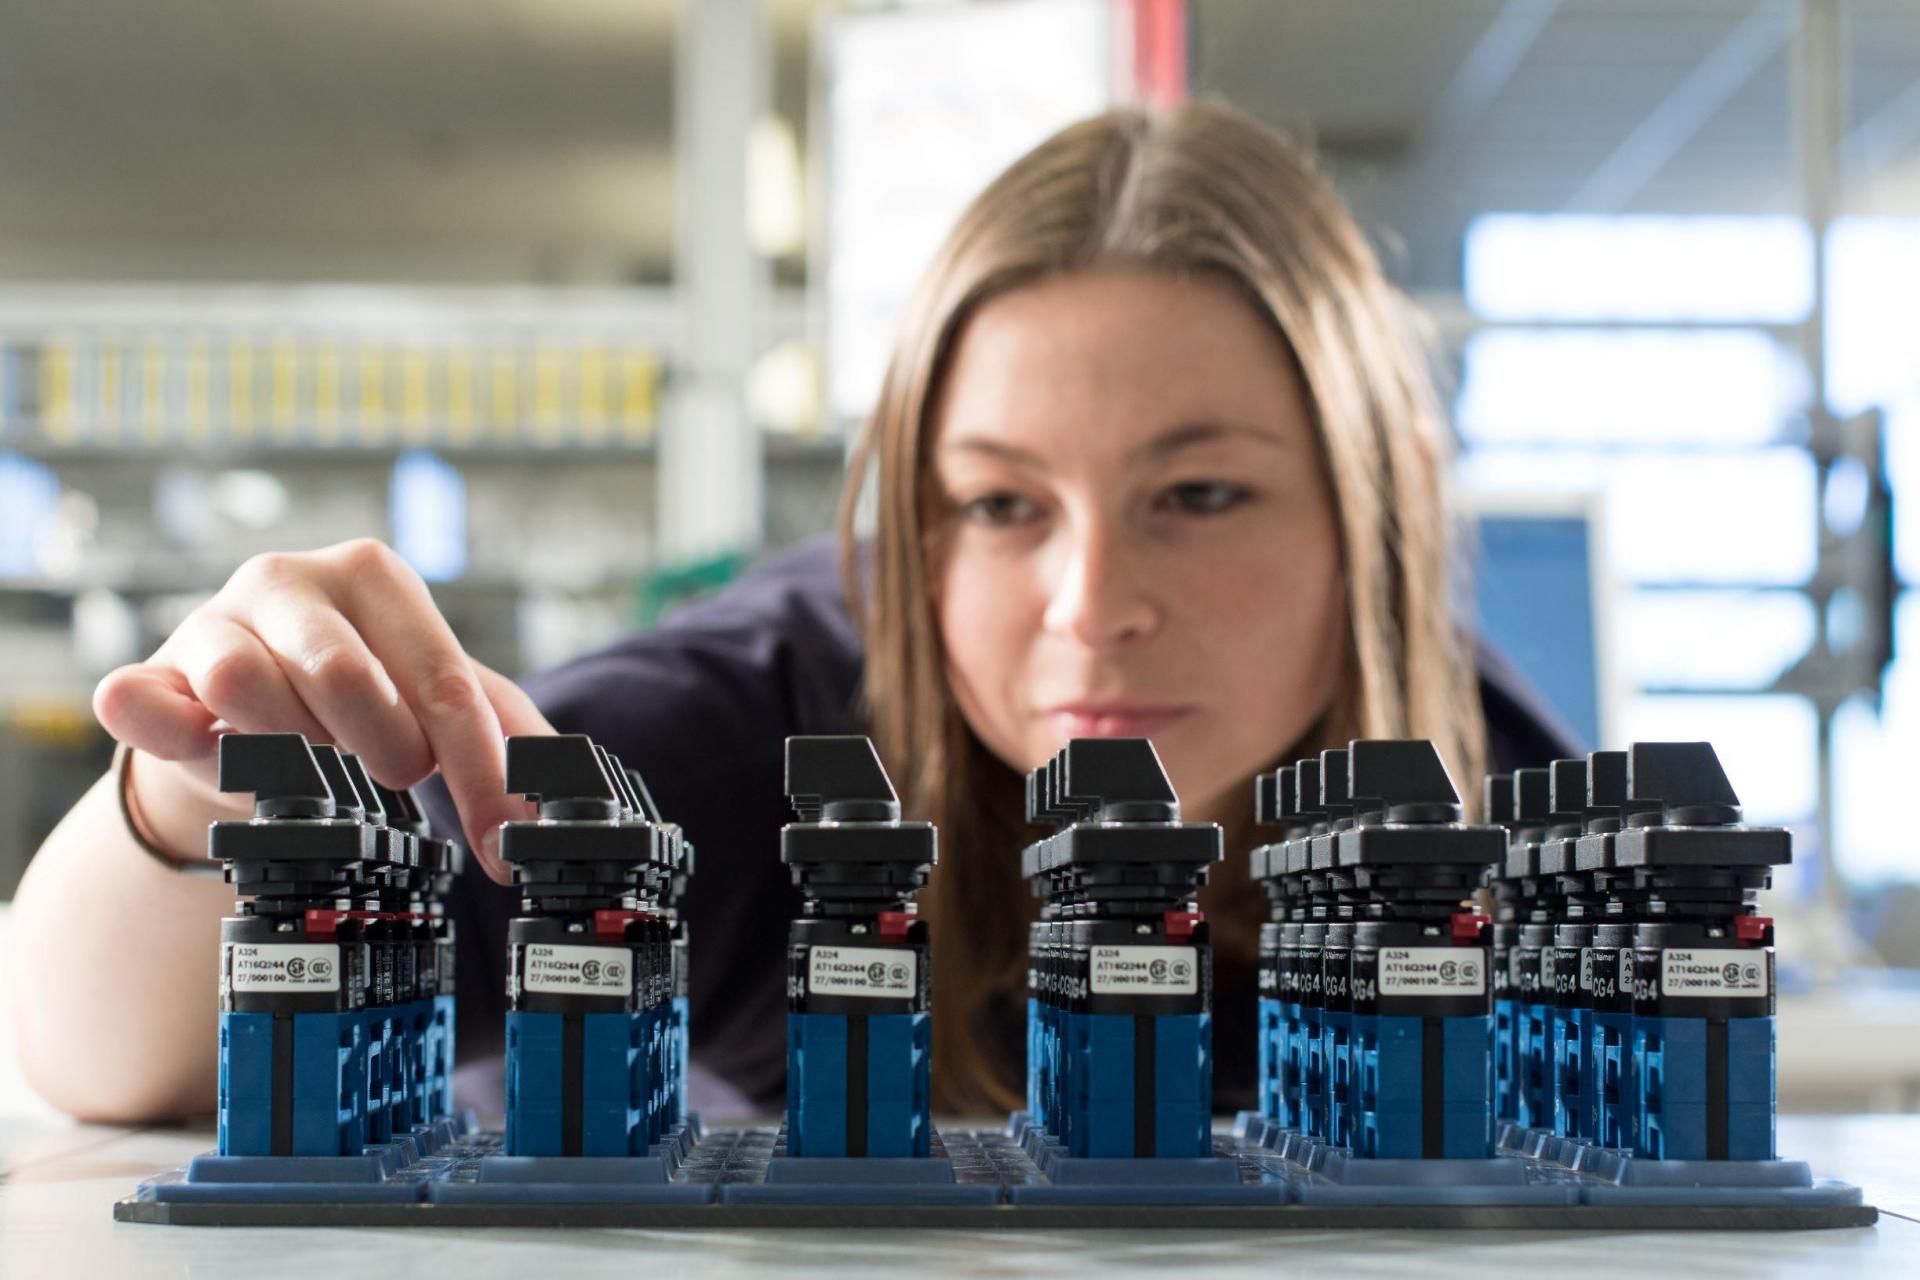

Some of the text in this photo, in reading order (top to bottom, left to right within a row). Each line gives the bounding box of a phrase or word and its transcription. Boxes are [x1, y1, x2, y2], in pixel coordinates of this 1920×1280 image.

[238, 948, 258, 956] A324
[531, 948, 553, 956] A324
[1096, 949, 1120, 957] A324
[1385, 951, 1409, 959] A324
[1668, 953, 1692, 961] A324
[238, 961, 285, 969] AT16Q244
[1300, 973, 1320, 992] CG4
[1325, 976, 1346, 996] CG4
[1556, 974, 1576, 993] CG4
[1593, 977, 1615, 997] CG4
[1352, 979, 1375, 1000] CG4
[1633, 979, 1658, 1000] CG4
